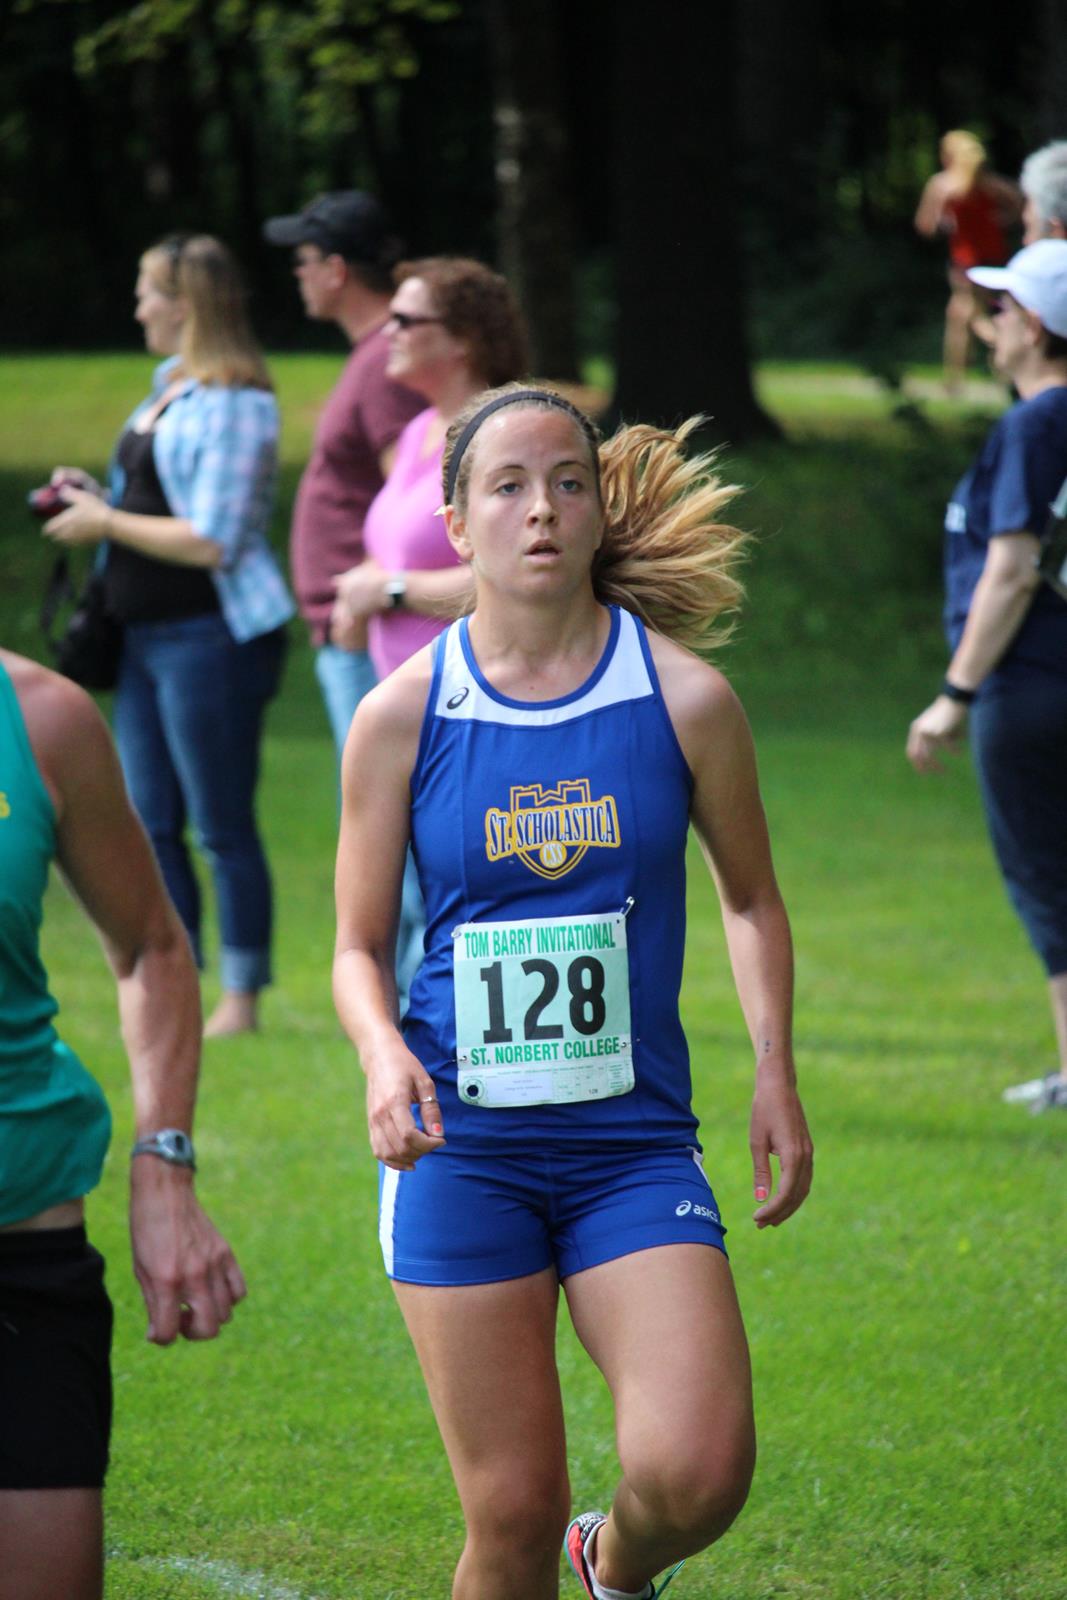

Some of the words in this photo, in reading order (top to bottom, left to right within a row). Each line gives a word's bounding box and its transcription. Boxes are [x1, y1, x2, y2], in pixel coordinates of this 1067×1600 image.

[516, 801, 616, 848] SCHOLASTICA
[464, 931, 490, 959] TOM
[493, 927, 533, 957] BARRY
[537, 922, 616, 953] INVITATIONAL
[480, 955, 606, 1044] 128
[471, 1047, 491, 1066] ST.
[495, 1042, 559, 1064] NORBERT
[564, 1036, 620, 1060] COLLEGE
